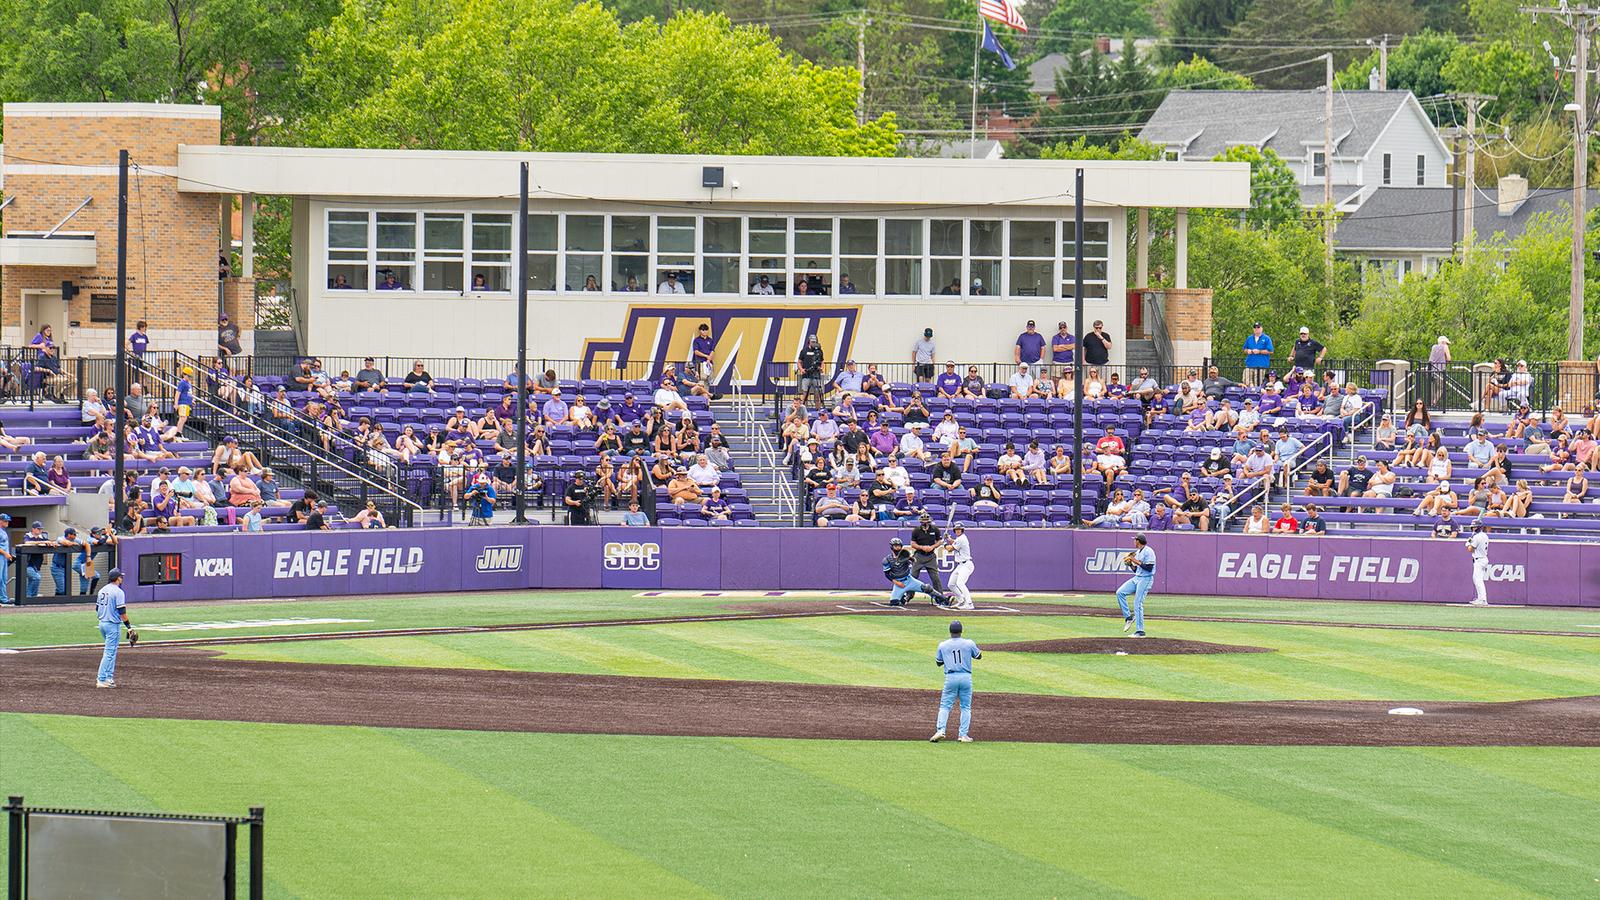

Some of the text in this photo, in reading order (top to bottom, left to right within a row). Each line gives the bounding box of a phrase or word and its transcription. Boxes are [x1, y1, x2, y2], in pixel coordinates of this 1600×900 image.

[586, 314, 851, 389] JMU
[165, 554, 180, 582] 14
[193, 558, 233, 577] NCAA
[273, 547, 425, 579] EAGLE FIELD
[477, 546, 523, 571] JMU
[604, 542, 660, 570] SBC
[1087, 550, 1137, 572] JM
[1218, 552, 1420, 584] EAGLE FIELD
[951, 649, 962, 665] 11
